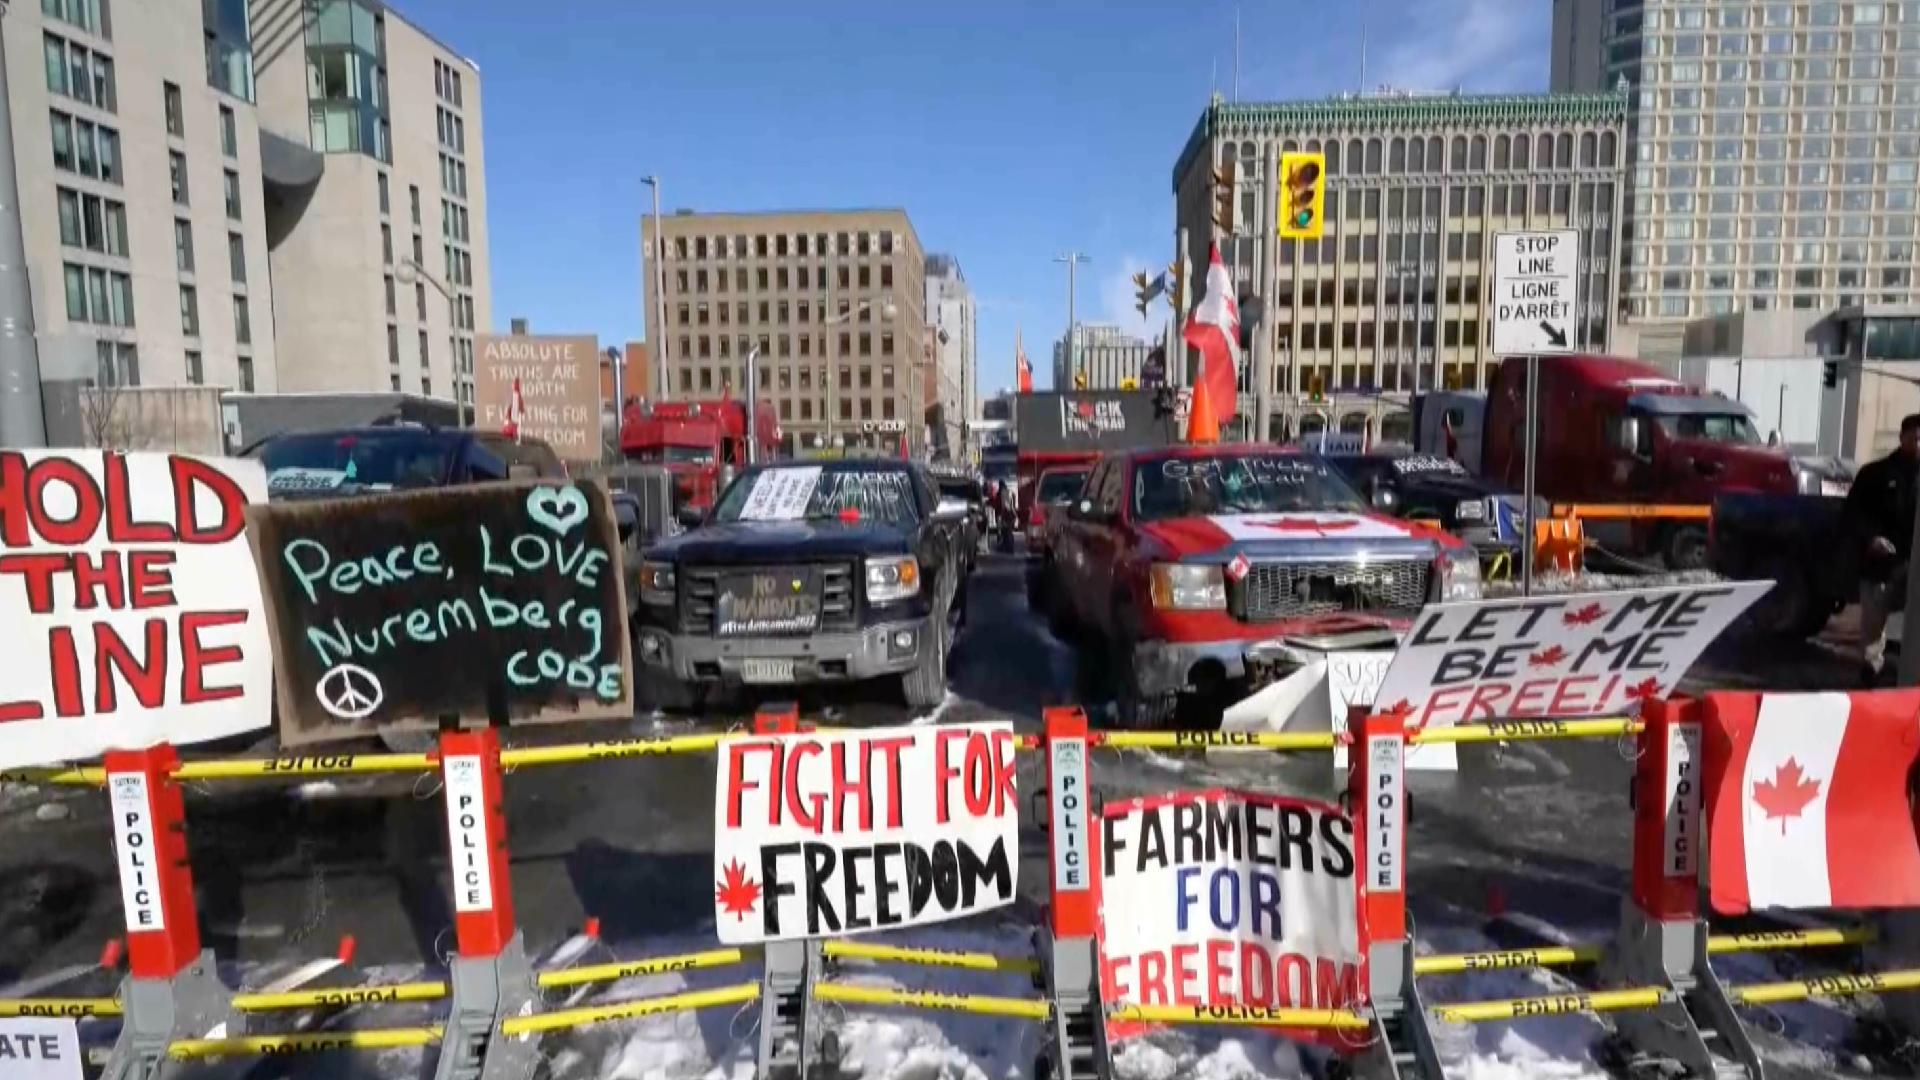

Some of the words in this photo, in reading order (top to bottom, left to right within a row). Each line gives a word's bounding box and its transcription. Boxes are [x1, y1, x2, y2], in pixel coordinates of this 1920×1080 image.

[1515, 236, 1559, 254] STOP
[1518, 257, 1554, 274] LINE
[1500, 300, 1569, 320] D'ARRÊT
[1511, 281, 1559, 298] LIGNE
[484, 341, 575, 361] ABSOLUTE
[489, 364, 543, 380] TRUTHS
[552, 363, 580, 380] ARE
[486, 404, 557, 424] FITING
[563, 404, 589, 423] FOR
[521, 426, 586, 446] REEDOM
[0, 550, 178, 614] THE
[283, 540, 455, 604] Peace,
[480, 524, 609, 587] LOVE
[307, 585, 602, 666] Nuremberg
[1410, 602, 1568, 647] LET
[1603, 588, 1735, 633] ME
[507, 650, 623, 699] CODE
[1431, 641, 1541, 687] BE
[1569, 630, 1686, 673] ME,
[1418, 674, 1623, 730] FREE!
[1176, 730, 1261, 745] POLICE
[726, 736, 916, 834] FIGHT
[934, 728, 1018, 823] FOR
[1062, 775, 1080, 885] POLICE
[1103, 799, 1356, 878] FARMERS
[1378, 773, 1394, 886] POLICE
[1675, 761, 1691, 871] POLICE
[126, 812, 153, 925] POLICE
[459, 795, 481, 905] POLICE
[760, 833, 1013, 937] FREEDOM
[1176, 867, 1283, 941] FOR
[1108, 939, 1357, 1008] FREEDOM
